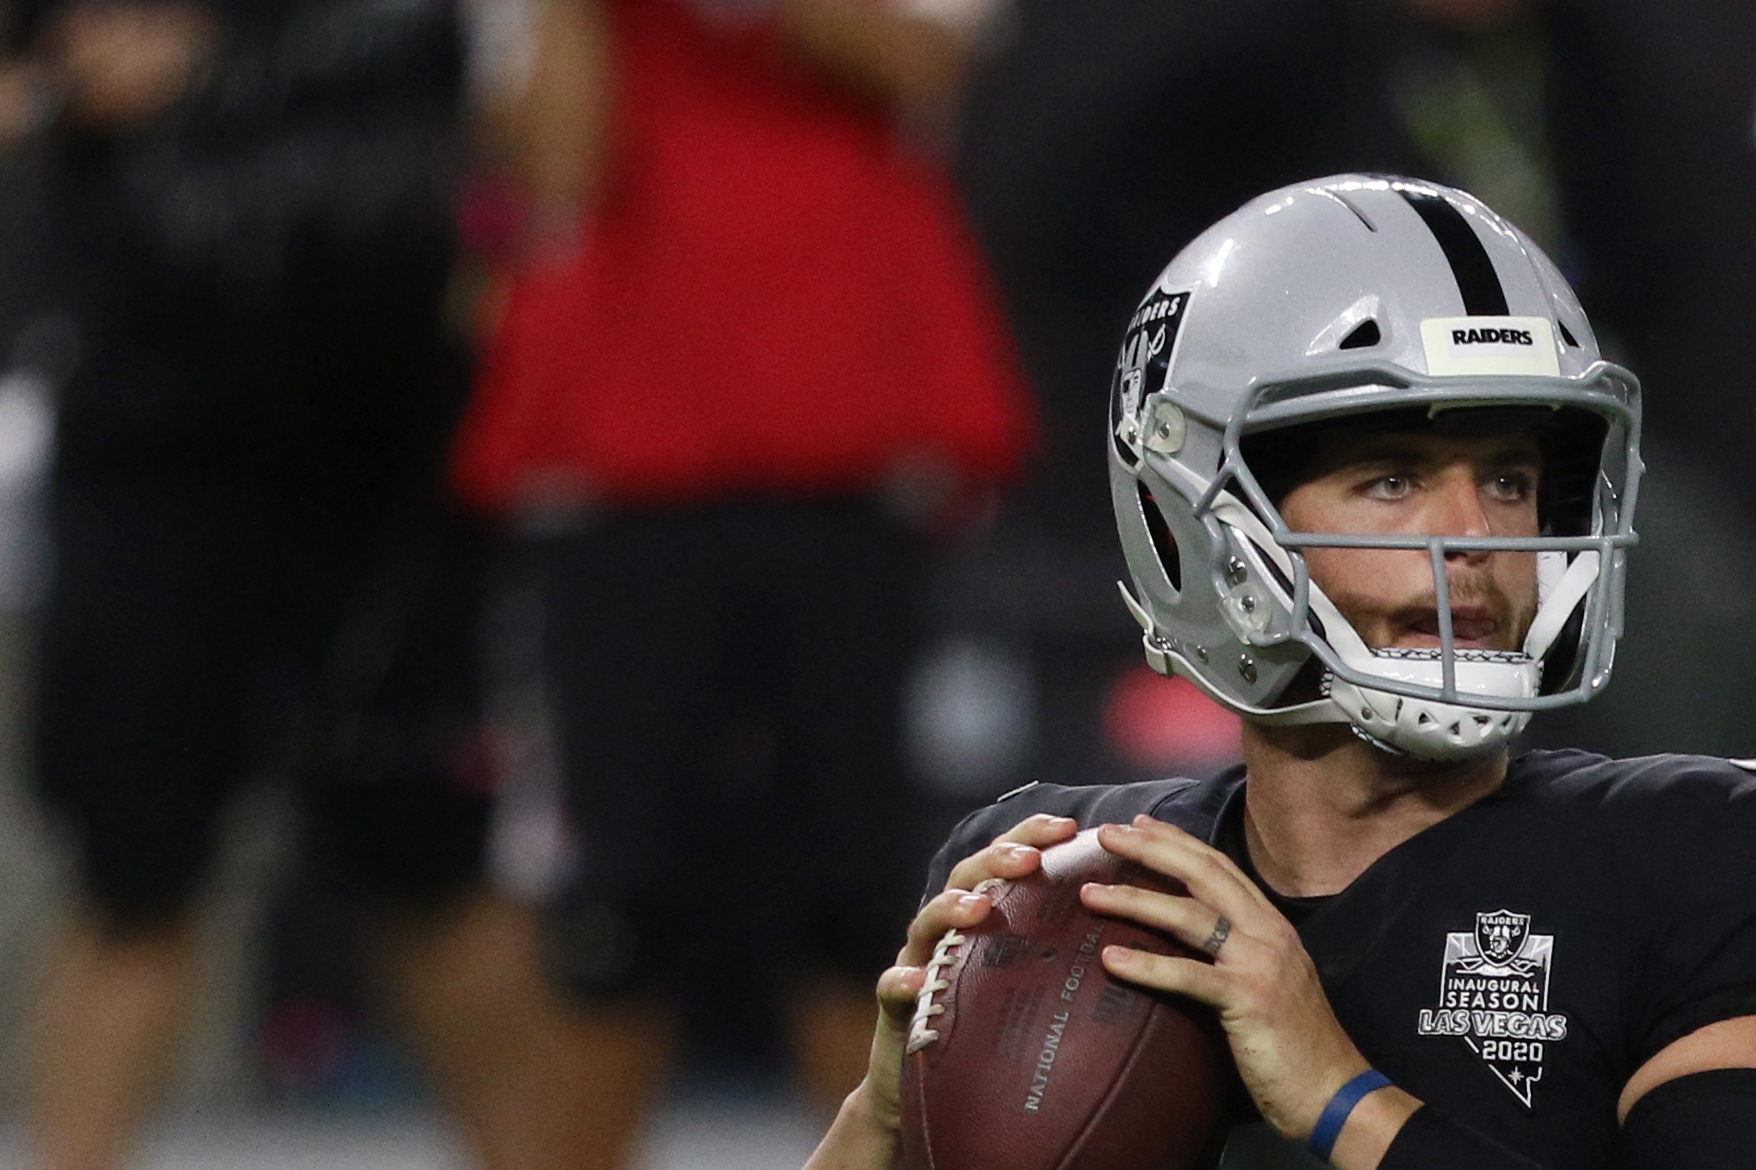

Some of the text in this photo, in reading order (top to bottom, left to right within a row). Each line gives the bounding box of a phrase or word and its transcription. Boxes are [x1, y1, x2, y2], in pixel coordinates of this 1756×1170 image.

[1127, 297, 1180, 333] AIDERS
[1451, 328, 1533, 346] RAIDERS
[1480, 916, 1525, 926] RAIDERS
[1448, 978, 1540, 994] INAUGURAL
[1446, 991, 1539, 1011] SEASON
[1024, 919, 1106, 1113] NATIONAL FOOTBAL
[1418, 1009, 1568, 1041] LAS VEGAS
[1482, 1040, 1544, 1062] 2020
